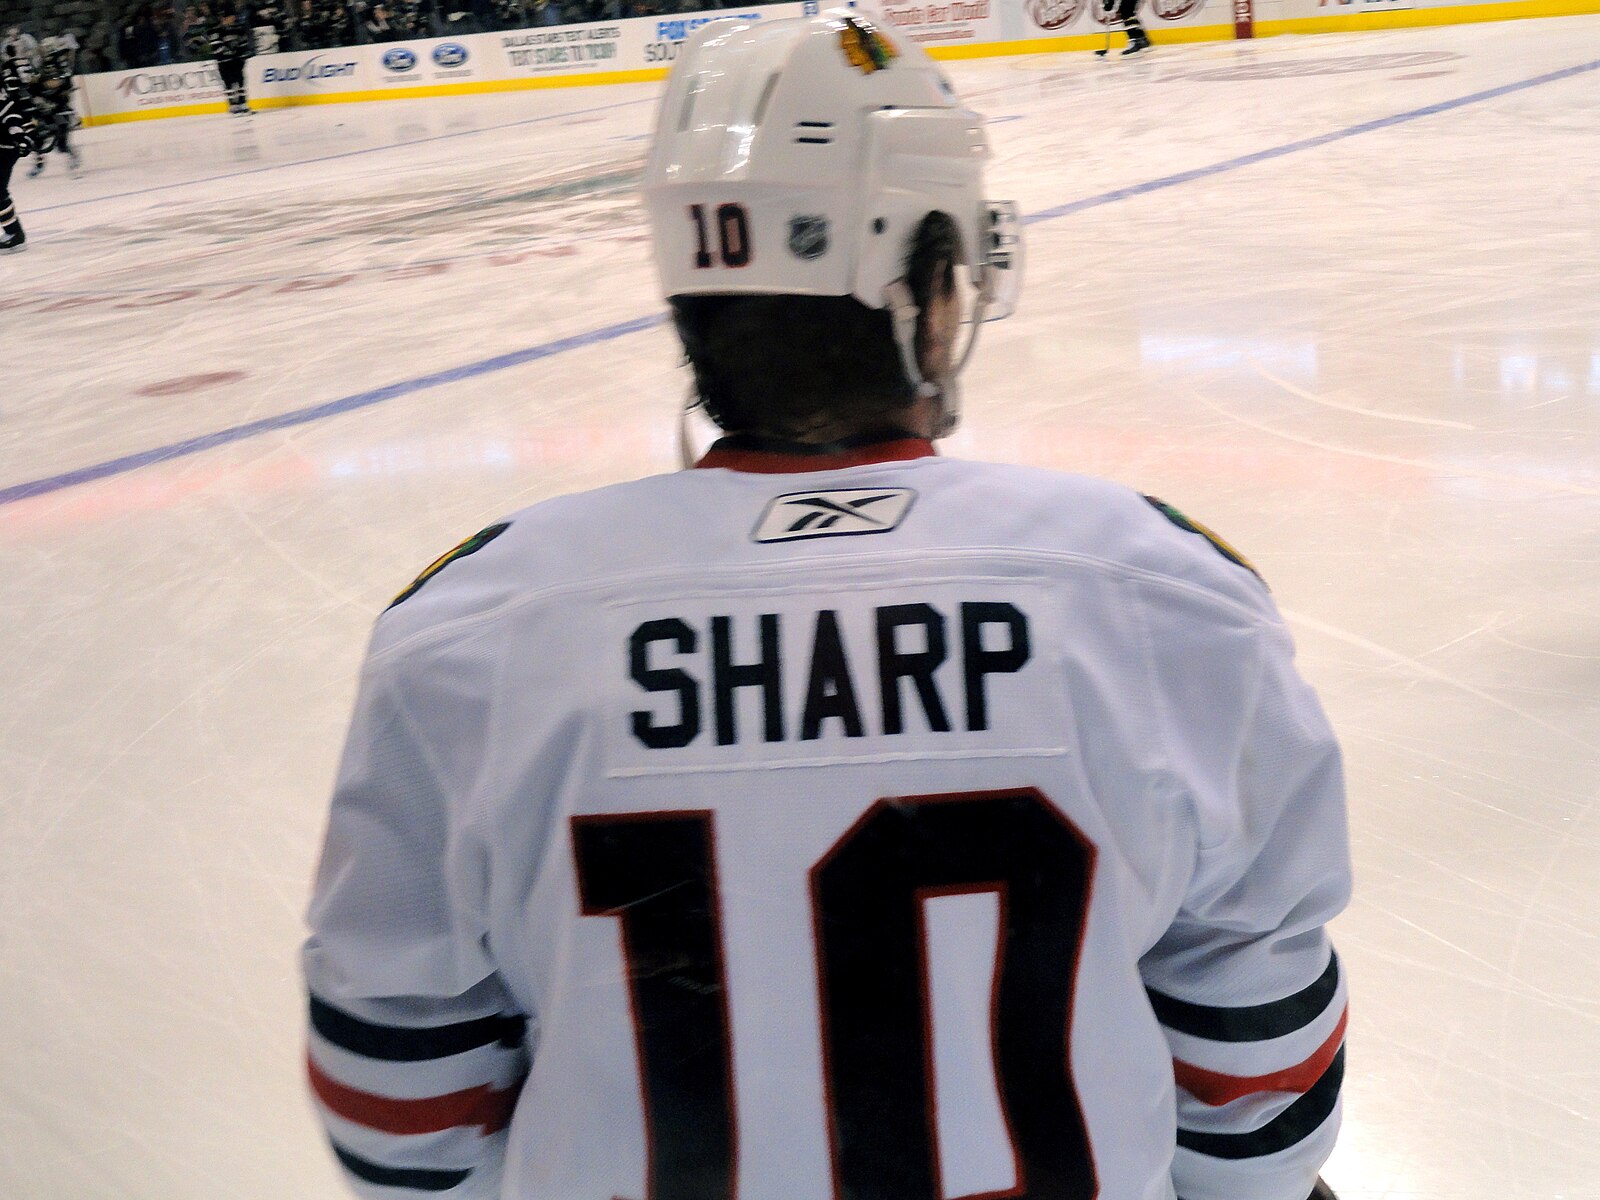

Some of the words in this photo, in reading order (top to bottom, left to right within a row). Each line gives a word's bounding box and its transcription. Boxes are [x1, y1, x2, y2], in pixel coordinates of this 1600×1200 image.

[684, 202, 753, 269] 10
[629, 601, 1033, 750] SHARP
[568, 786, 1100, 1200] 10
